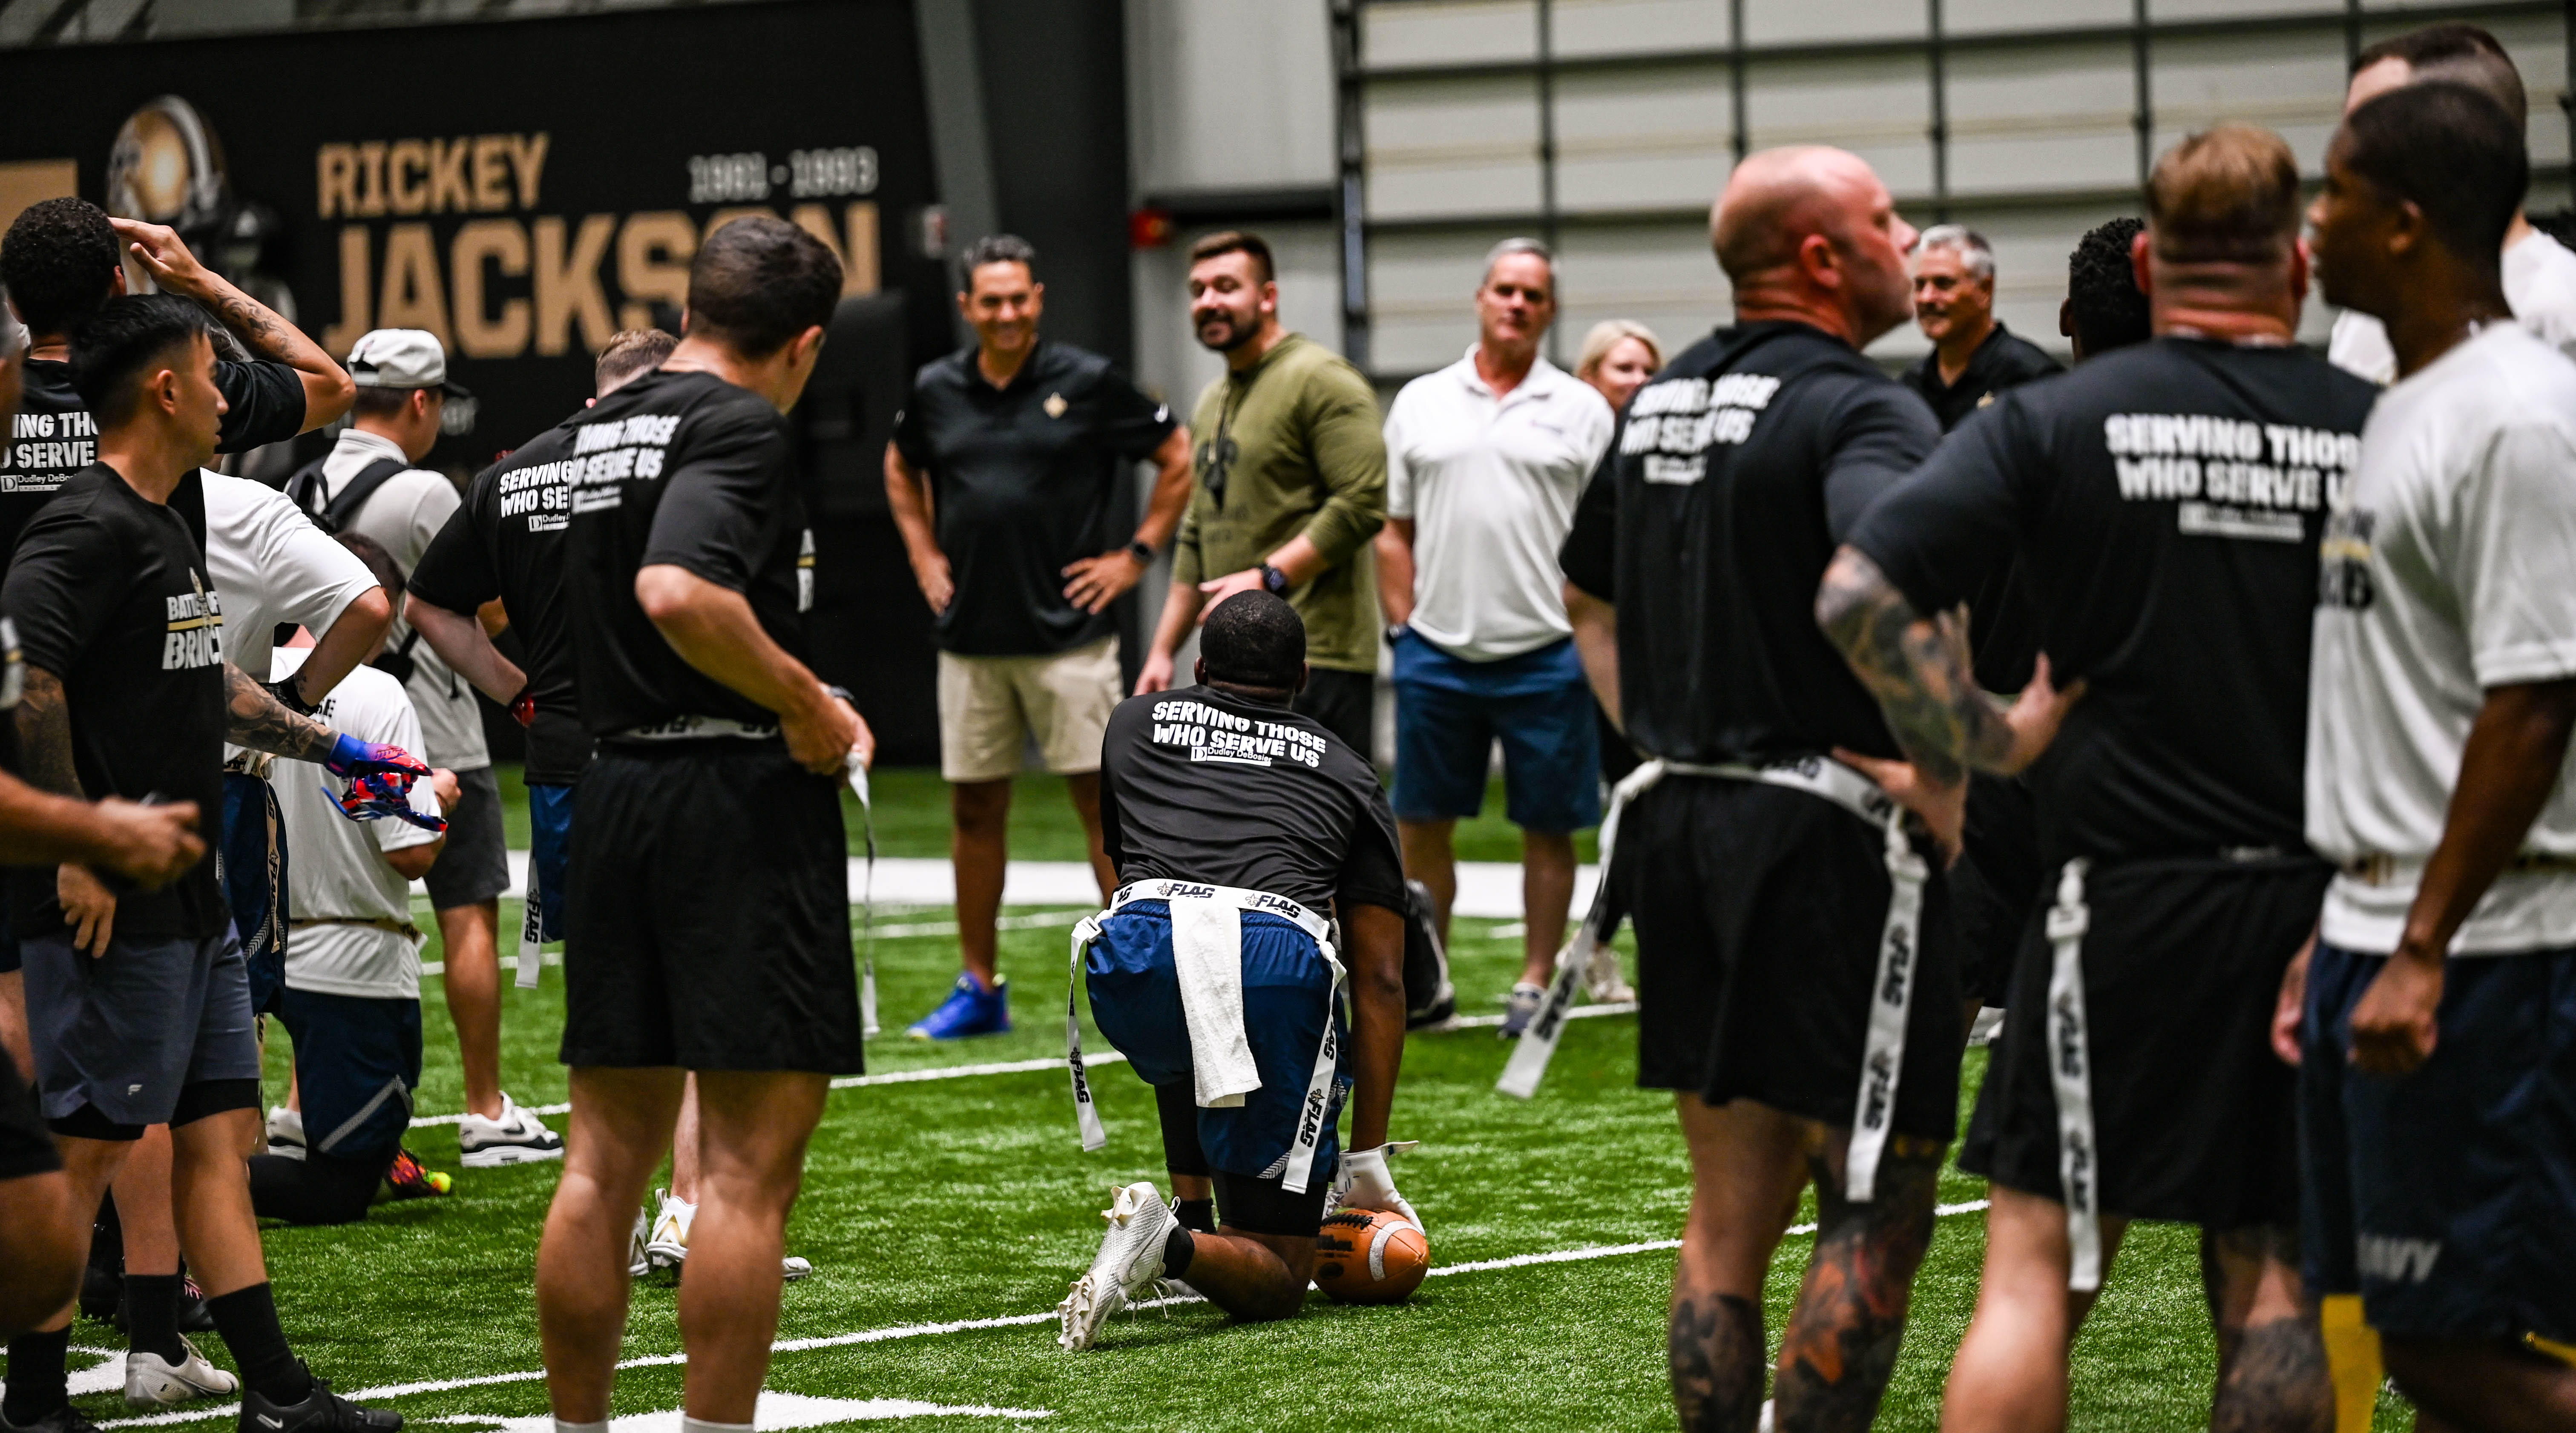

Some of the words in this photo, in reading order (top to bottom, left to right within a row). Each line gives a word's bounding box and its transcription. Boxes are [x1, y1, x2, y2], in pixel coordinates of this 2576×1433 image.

[316, 132, 549, 220] RICKEY
[320, 201, 882, 360] JACKSN
[16, 440, 95, 468] SERVE
[2104, 412, 2263, 461] SERVING
[2264, 422, 2362, 469] THOS
[17, 475, 46, 484] Dudley
[634, 446, 666, 480] US
[2114, 454, 2203, 502] WHO
[2205, 460, 2321, 511] SERVE
[500, 488, 538, 518] WHO
[542, 485, 571, 511] SE
[542, 513, 566, 523] Dudley
[1152, 701, 1251, 732] SERVING
[1254, 720, 1326, 753] THOSE
[1153, 723, 1206, 747] WHO
[1210, 729, 1286, 757] SERVE
[1290, 743, 1320, 768] US
[1208, 747, 1235, 758] Dudley
[1236, 750, 1272, 762] DeBosier
[1166, 883, 1215, 899] FLAG
[1254, 895, 1301, 919] FLAG
[524, 898, 541, 944] FLAG
[1070, 1059, 1090, 1103] FLAG
[1300, 1097, 1323, 1148] FLAG
